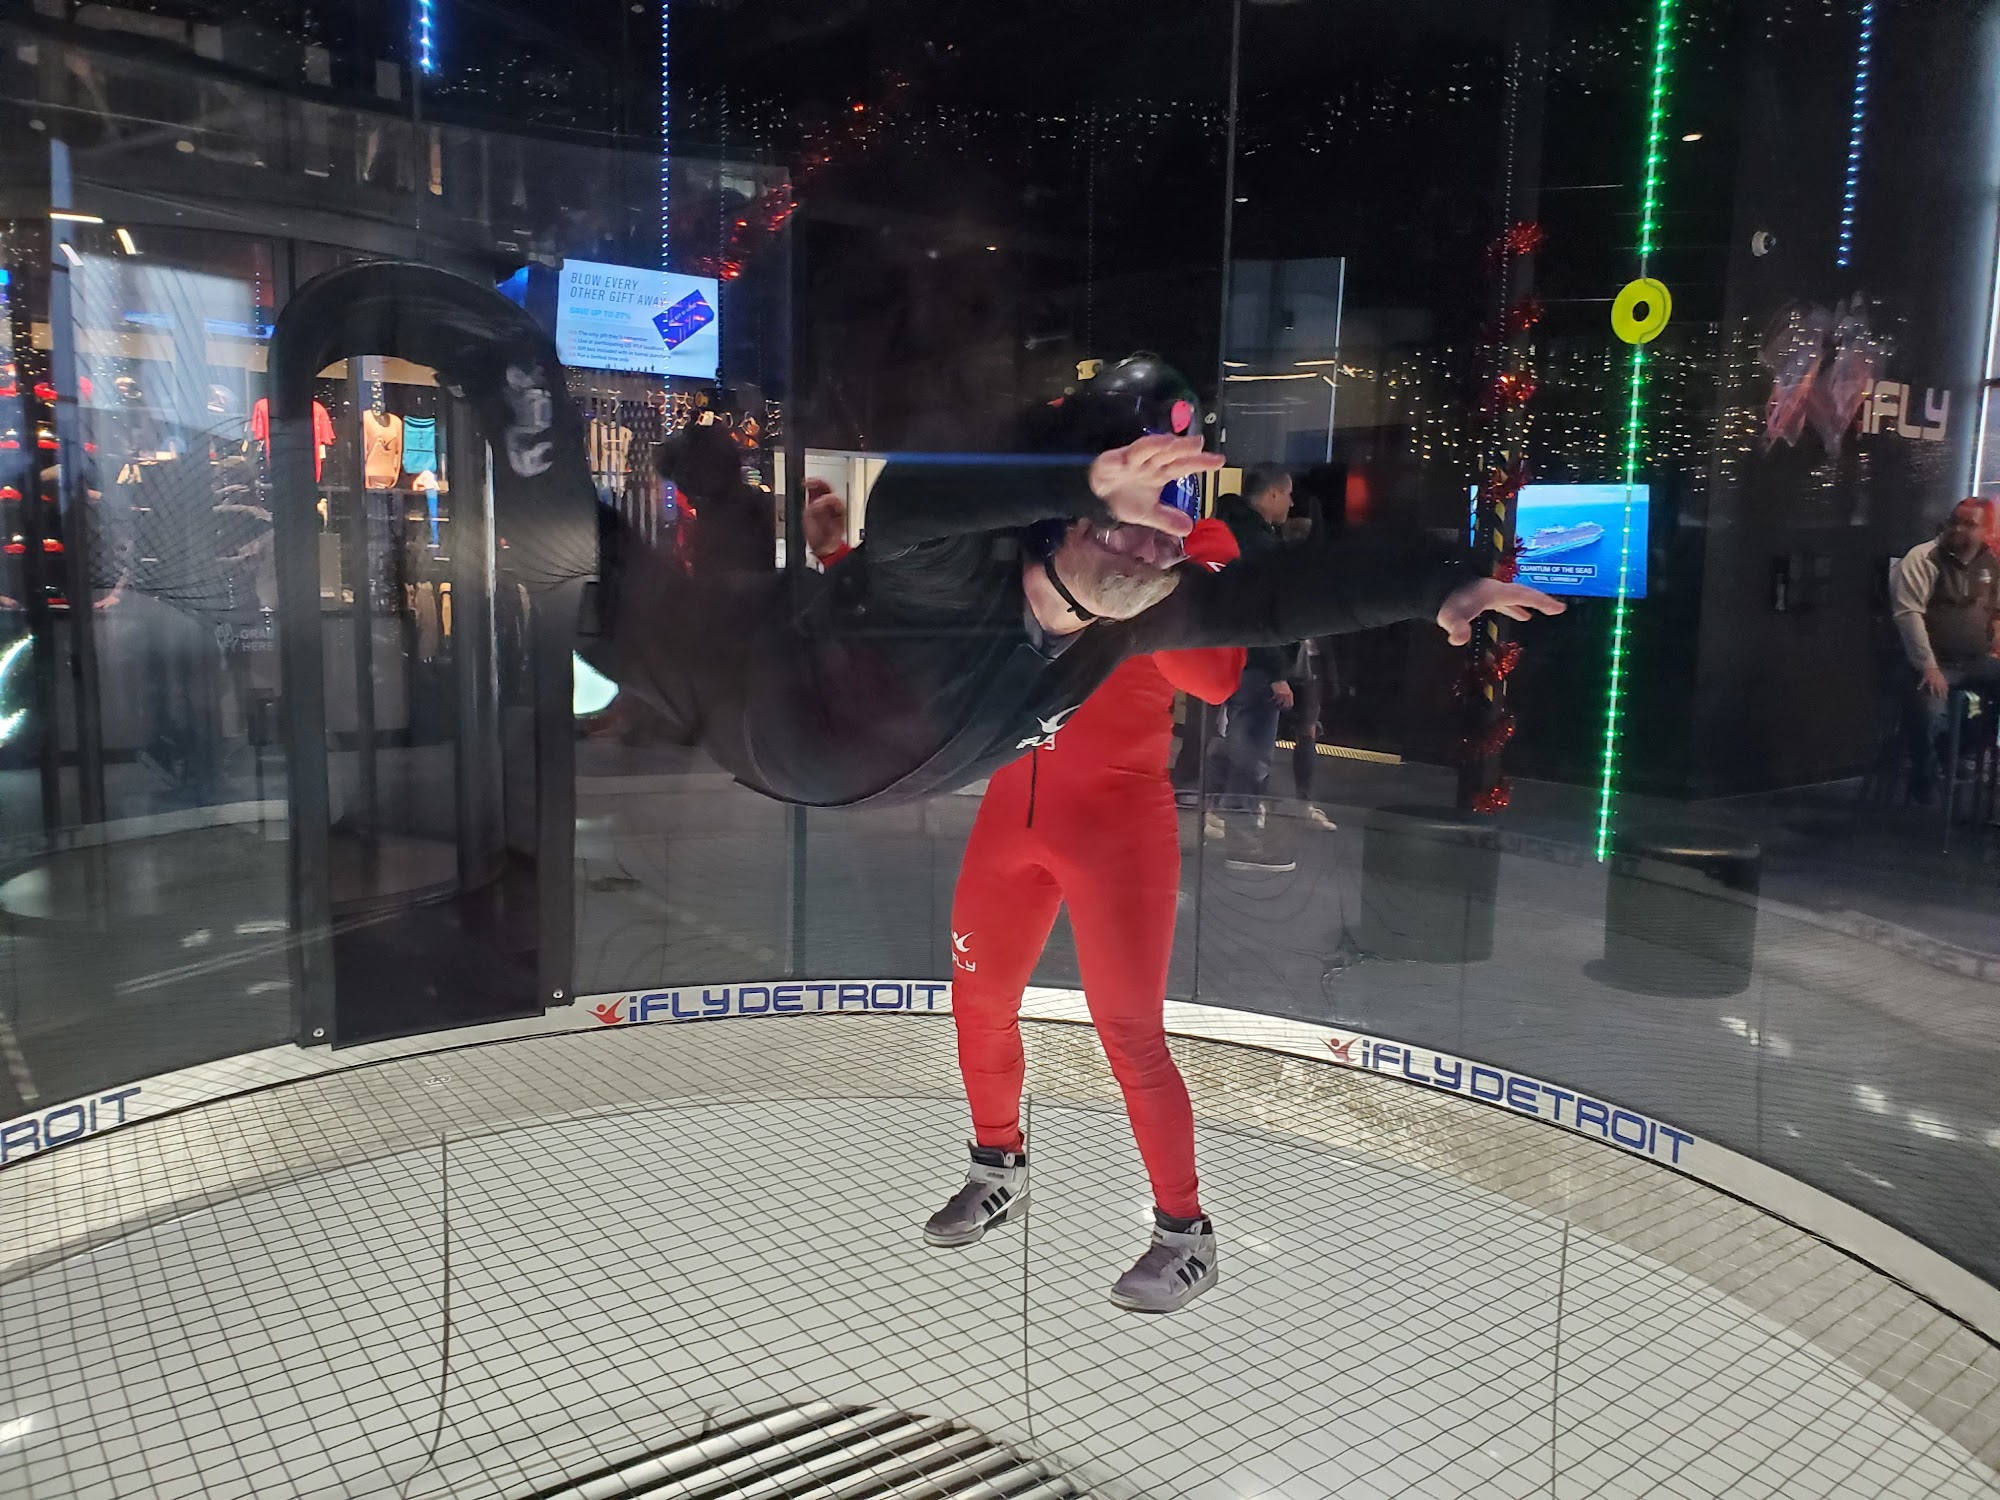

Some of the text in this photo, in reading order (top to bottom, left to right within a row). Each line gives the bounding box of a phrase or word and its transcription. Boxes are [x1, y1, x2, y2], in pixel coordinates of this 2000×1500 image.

[571, 272, 638, 290] BLOW EVERY
[570, 286, 605, 301] OTHER
[609, 291, 634, 304] GIFT
[569, 307, 589, 315] SAVE
[591, 308, 601, 316] UP
[604, 310, 613, 318] TO
[1862, 377, 1950, 442] iFLY
[1520, 565, 1550, 573] QUANTUM
[1561, 566, 1574, 574] THE
[0, 1086, 141, 1163] ROIT
